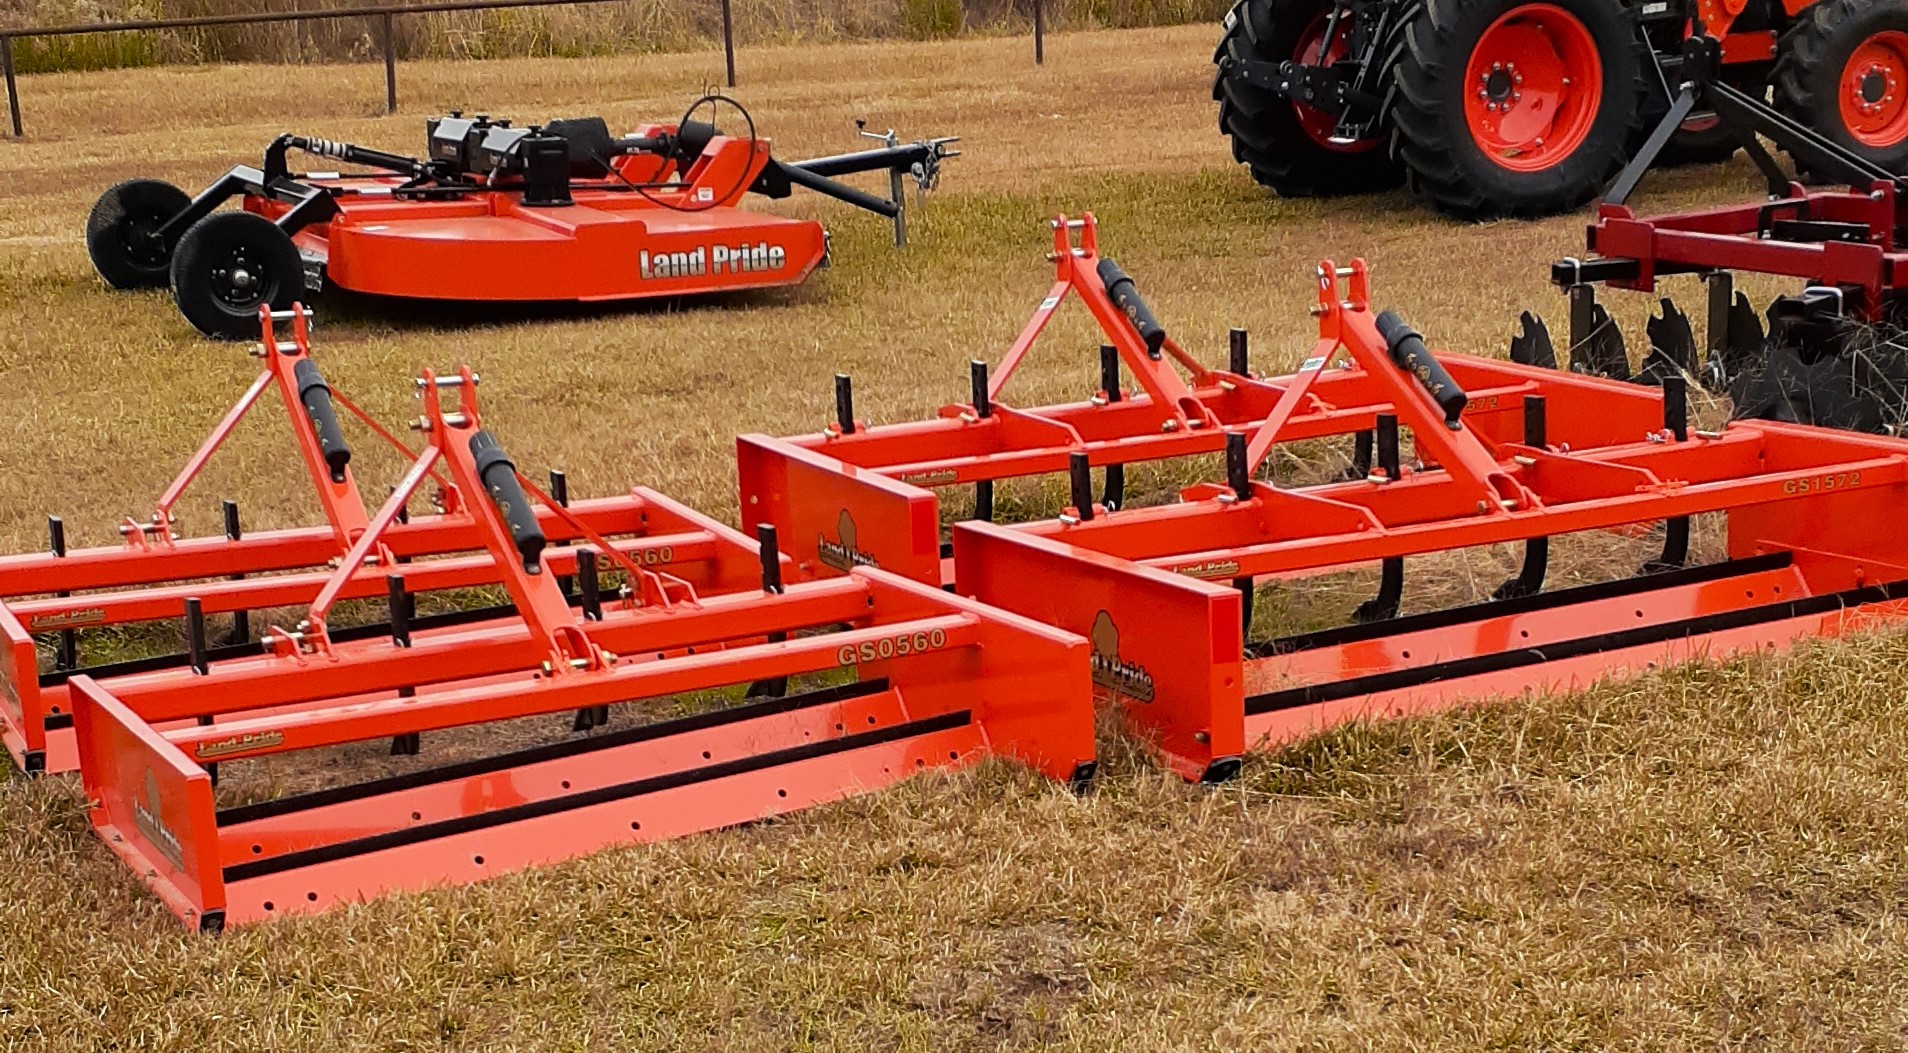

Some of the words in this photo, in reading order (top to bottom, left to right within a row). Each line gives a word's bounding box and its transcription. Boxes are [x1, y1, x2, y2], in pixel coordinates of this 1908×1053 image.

[640, 246, 706, 280] Land
[713, 242, 785, 274] Pride
[1466, 396, 1498, 411] 572
[1782, 472, 1860, 494] GS1572
[838, 628, 946, 665] GS0560
[1112, 655, 1152, 689] Pride
